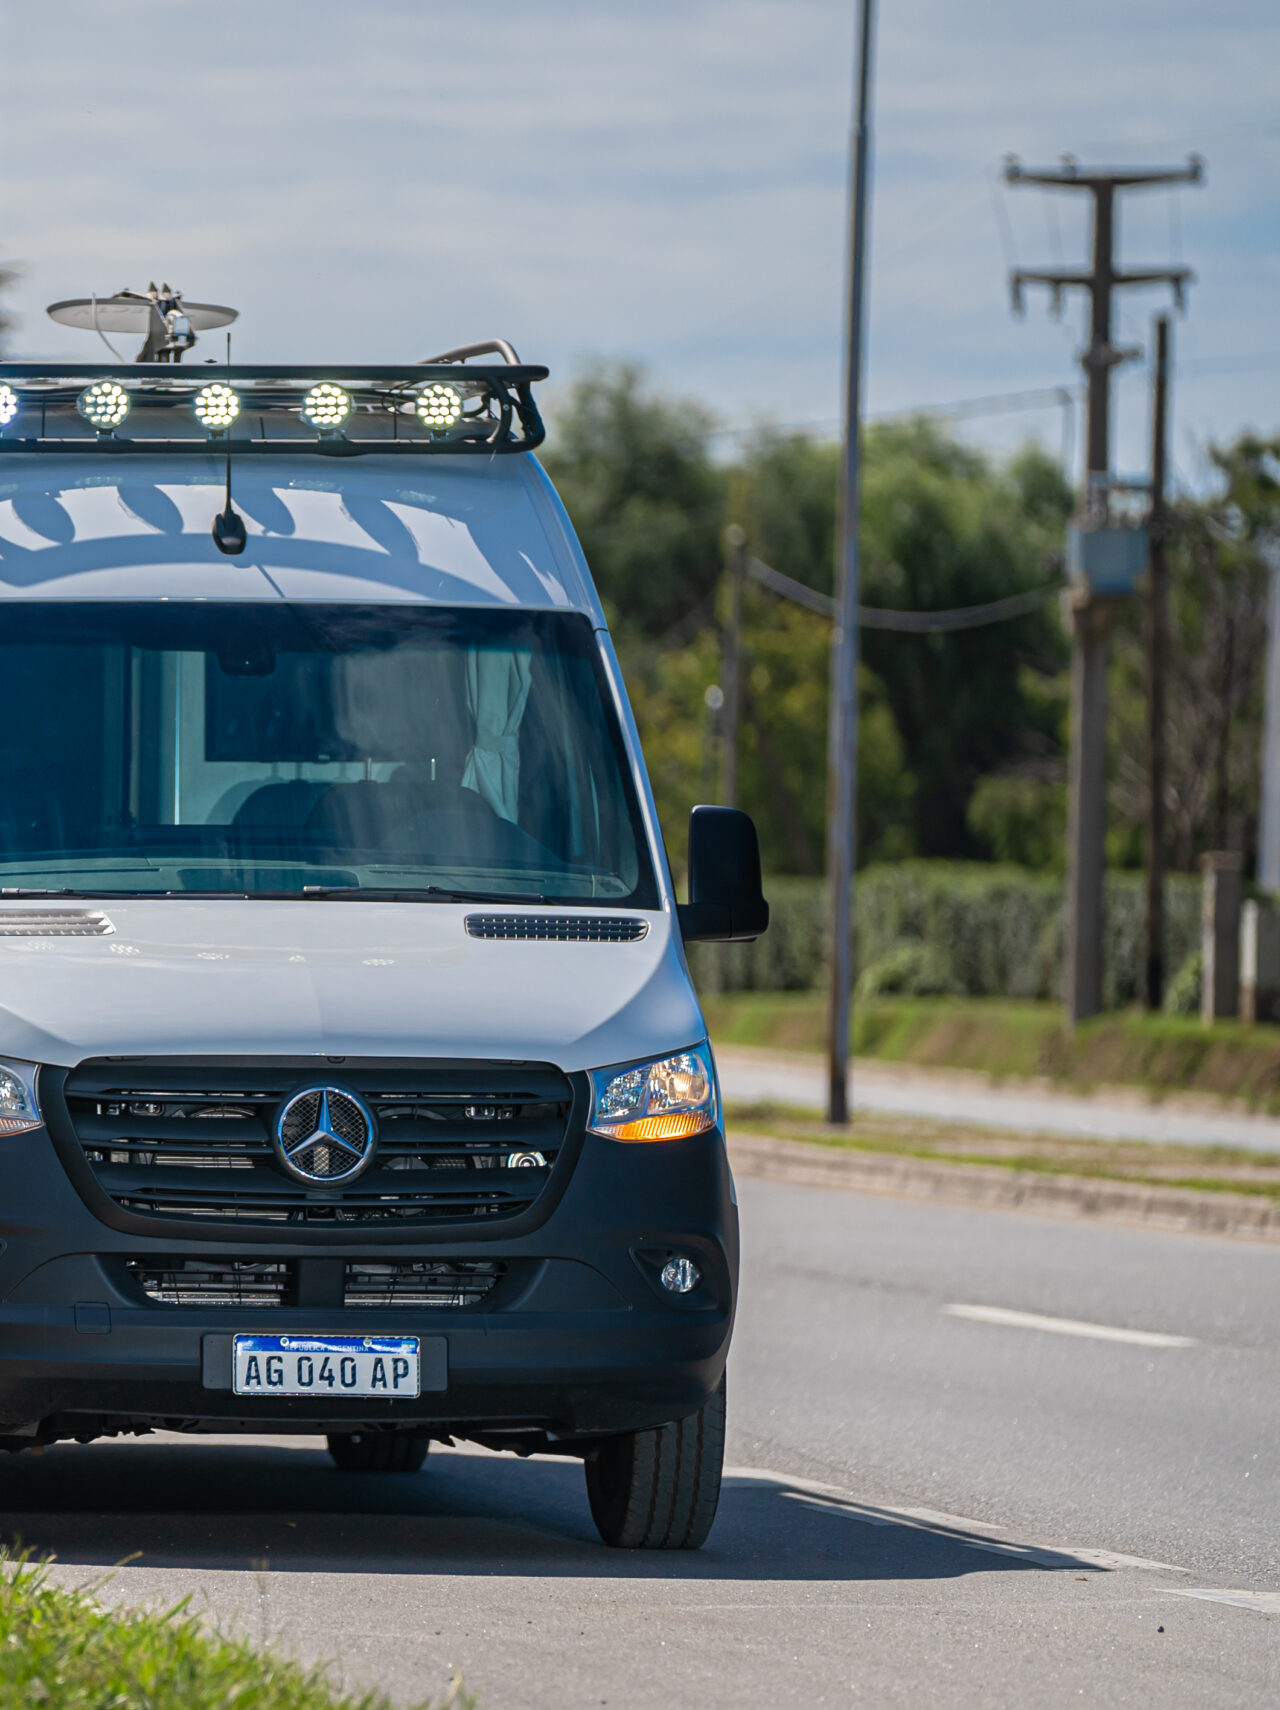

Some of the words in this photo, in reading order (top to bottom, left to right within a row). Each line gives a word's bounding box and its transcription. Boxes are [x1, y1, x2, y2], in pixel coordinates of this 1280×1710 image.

[244, 1355, 284, 1388] AG
[297, 1356, 357, 1388] 040
[371, 1357, 409, 1390] AP
